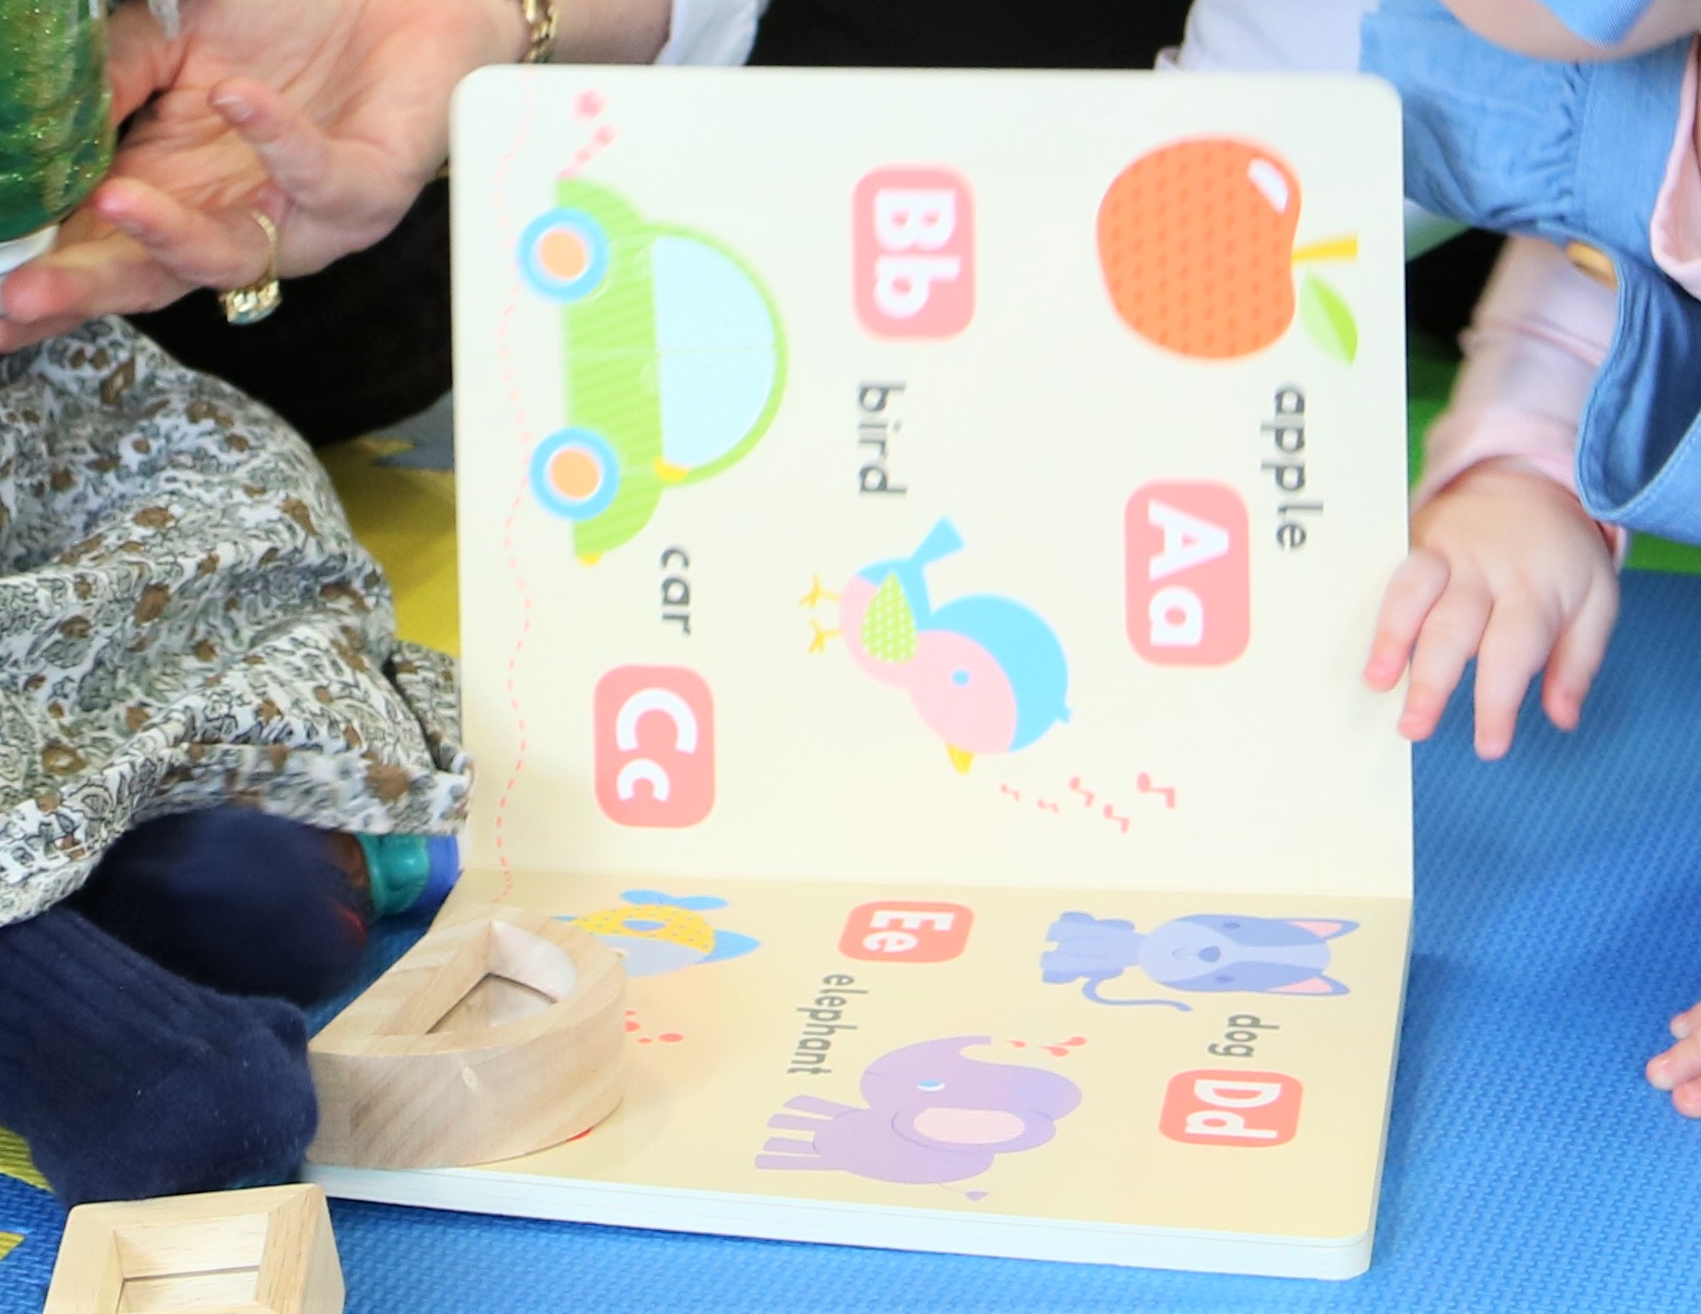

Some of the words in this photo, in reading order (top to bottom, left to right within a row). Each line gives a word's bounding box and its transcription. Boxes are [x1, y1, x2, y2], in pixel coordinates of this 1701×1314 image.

[874, 188, 962, 318] Bb
[857, 380, 908, 498] bird
[1259, 384, 1324, 552] apple
[659, 544, 692, 635] car
[1147, 500, 1231, 649] Aa
[614, 687, 698, 804] Cc
[861, 909, 955, 953] Ee
[784, 972, 859, 1077] elephant
[1206, 1012, 1281, 1060] dog
[1183, 1077, 1284, 1140] Dd
